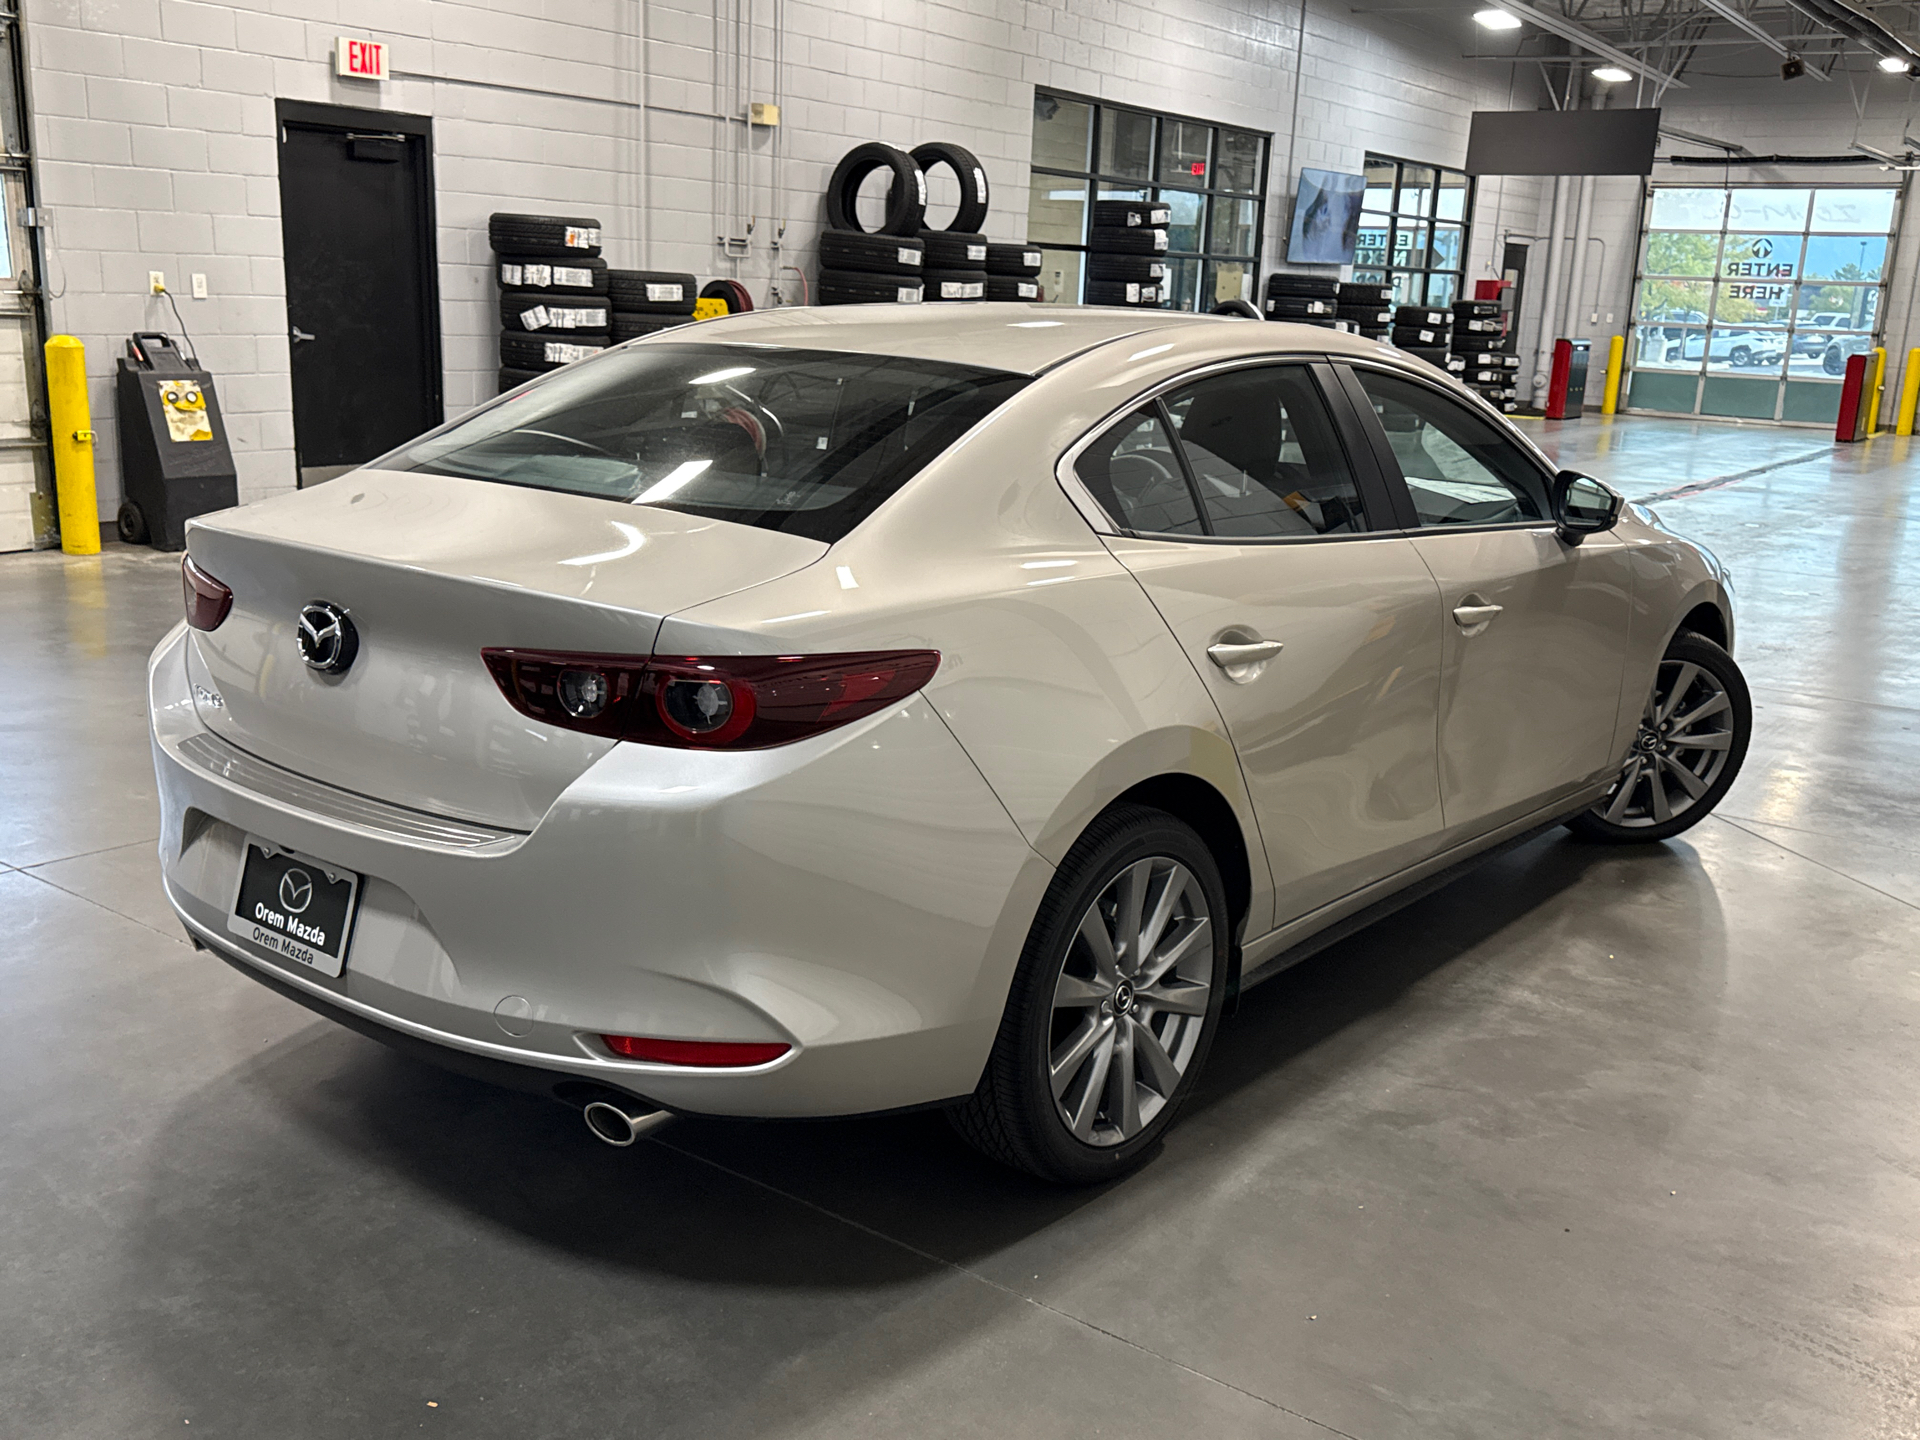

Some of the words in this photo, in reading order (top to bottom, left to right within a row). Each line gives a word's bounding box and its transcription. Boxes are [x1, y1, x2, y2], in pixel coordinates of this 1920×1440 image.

[349, 41, 381, 75] EXIT
[255, 902, 284, 929] Orem
[286, 915, 325, 946] Mazda
[253, 927, 278, 949] Orem
[281, 939, 314, 965] Mazda
